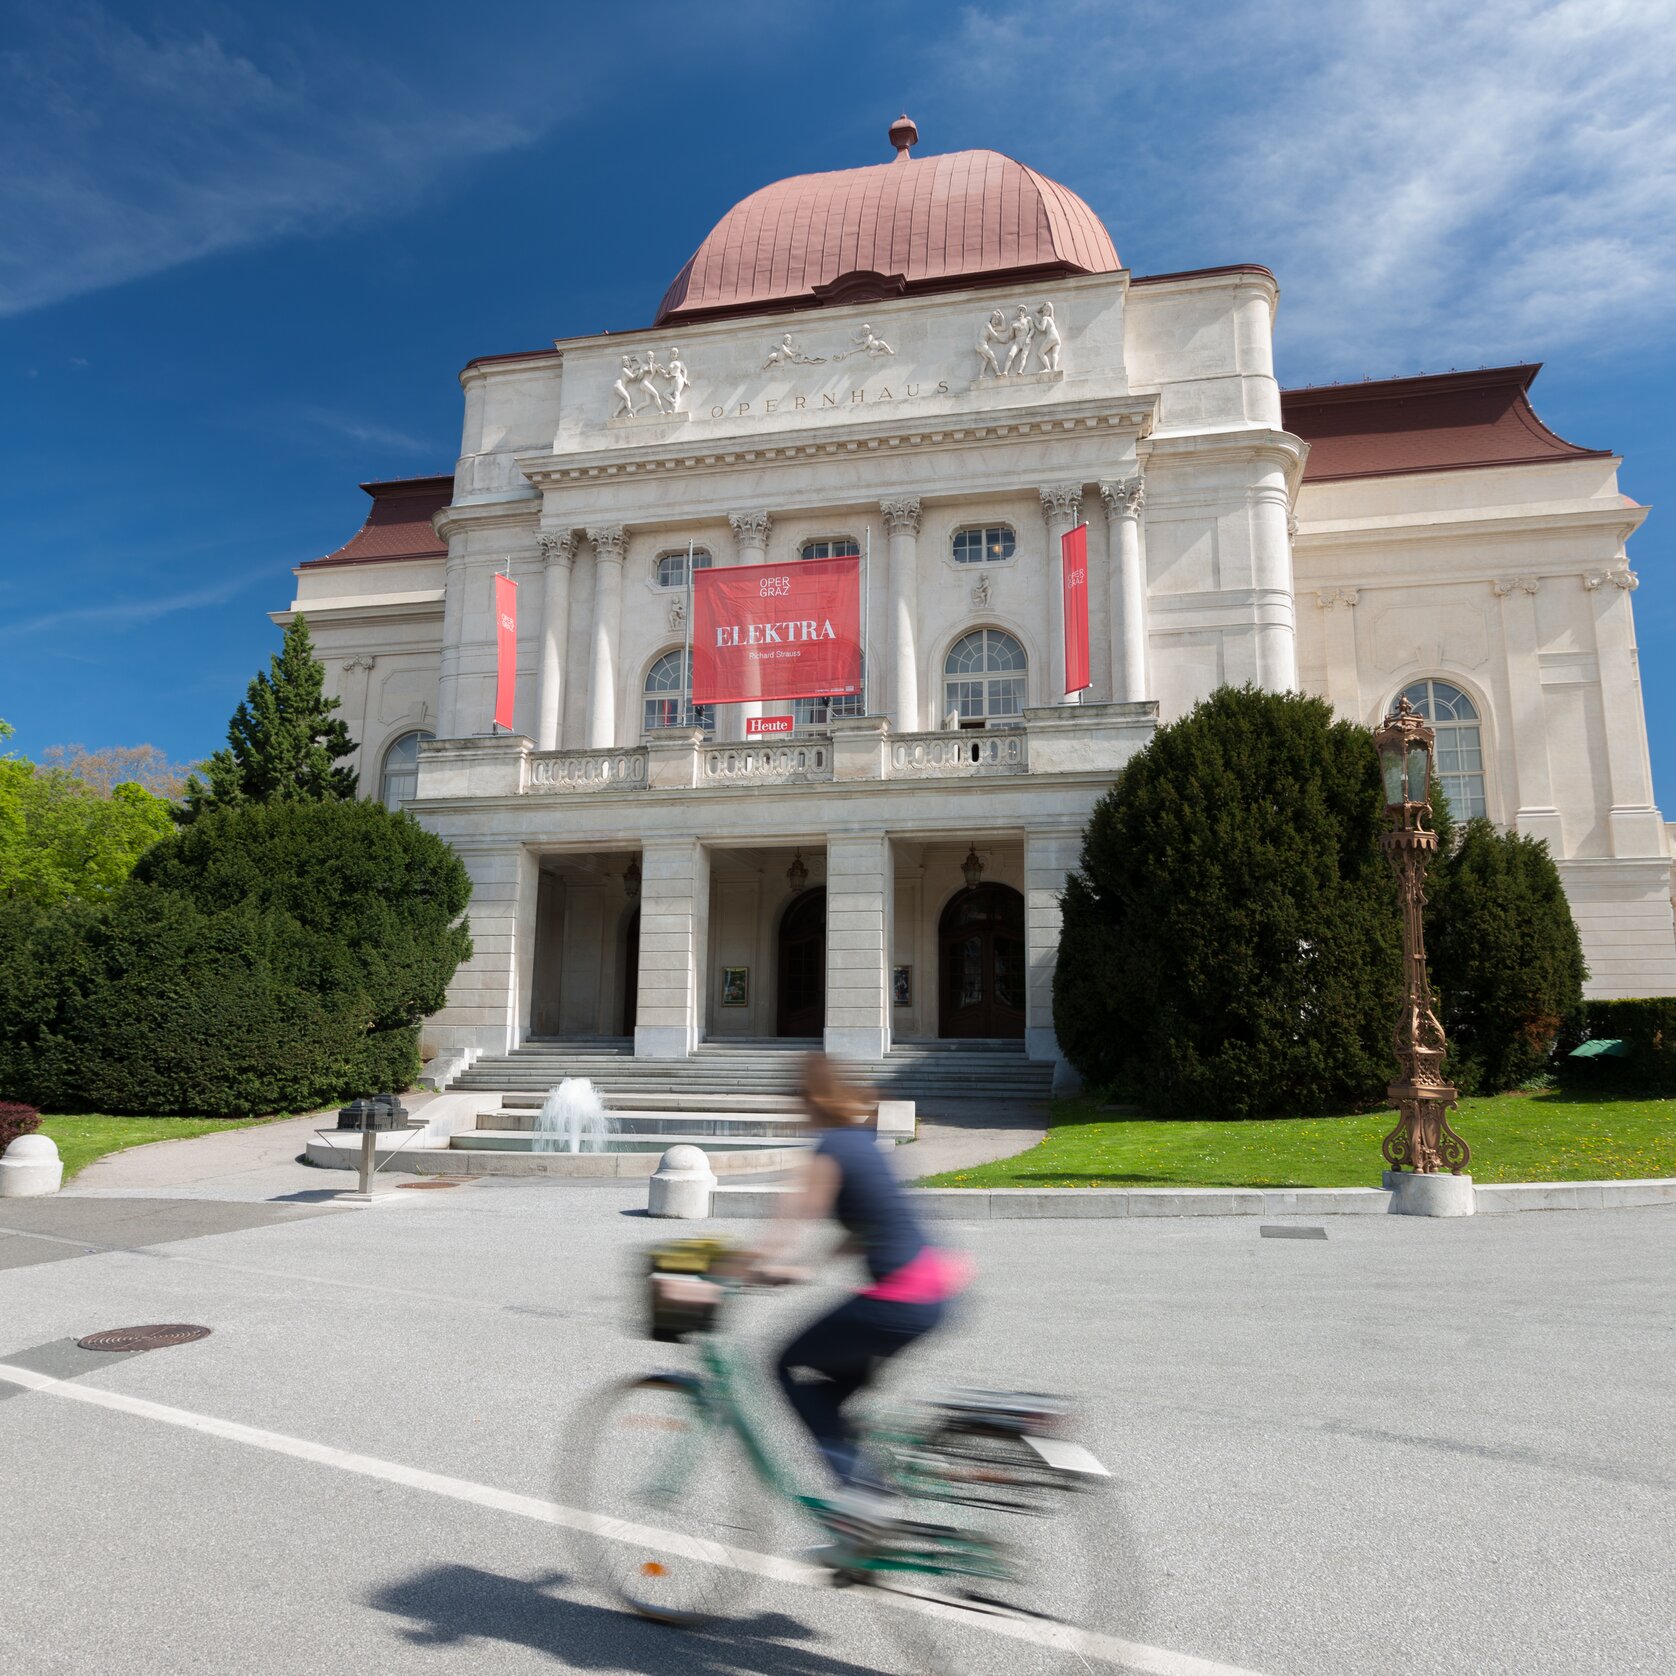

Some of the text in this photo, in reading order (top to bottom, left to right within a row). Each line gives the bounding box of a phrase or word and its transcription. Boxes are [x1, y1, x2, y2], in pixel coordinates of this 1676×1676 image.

[711, 380, 949, 418] OPERNHAUS
[759, 576, 791, 588] OPER
[759, 586, 789, 598] GRAZ
[716, 619, 836, 647] ELEKTRA
[749, 650, 801, 660] Richard Strauss
[750, 719, 788, 732] Heute
